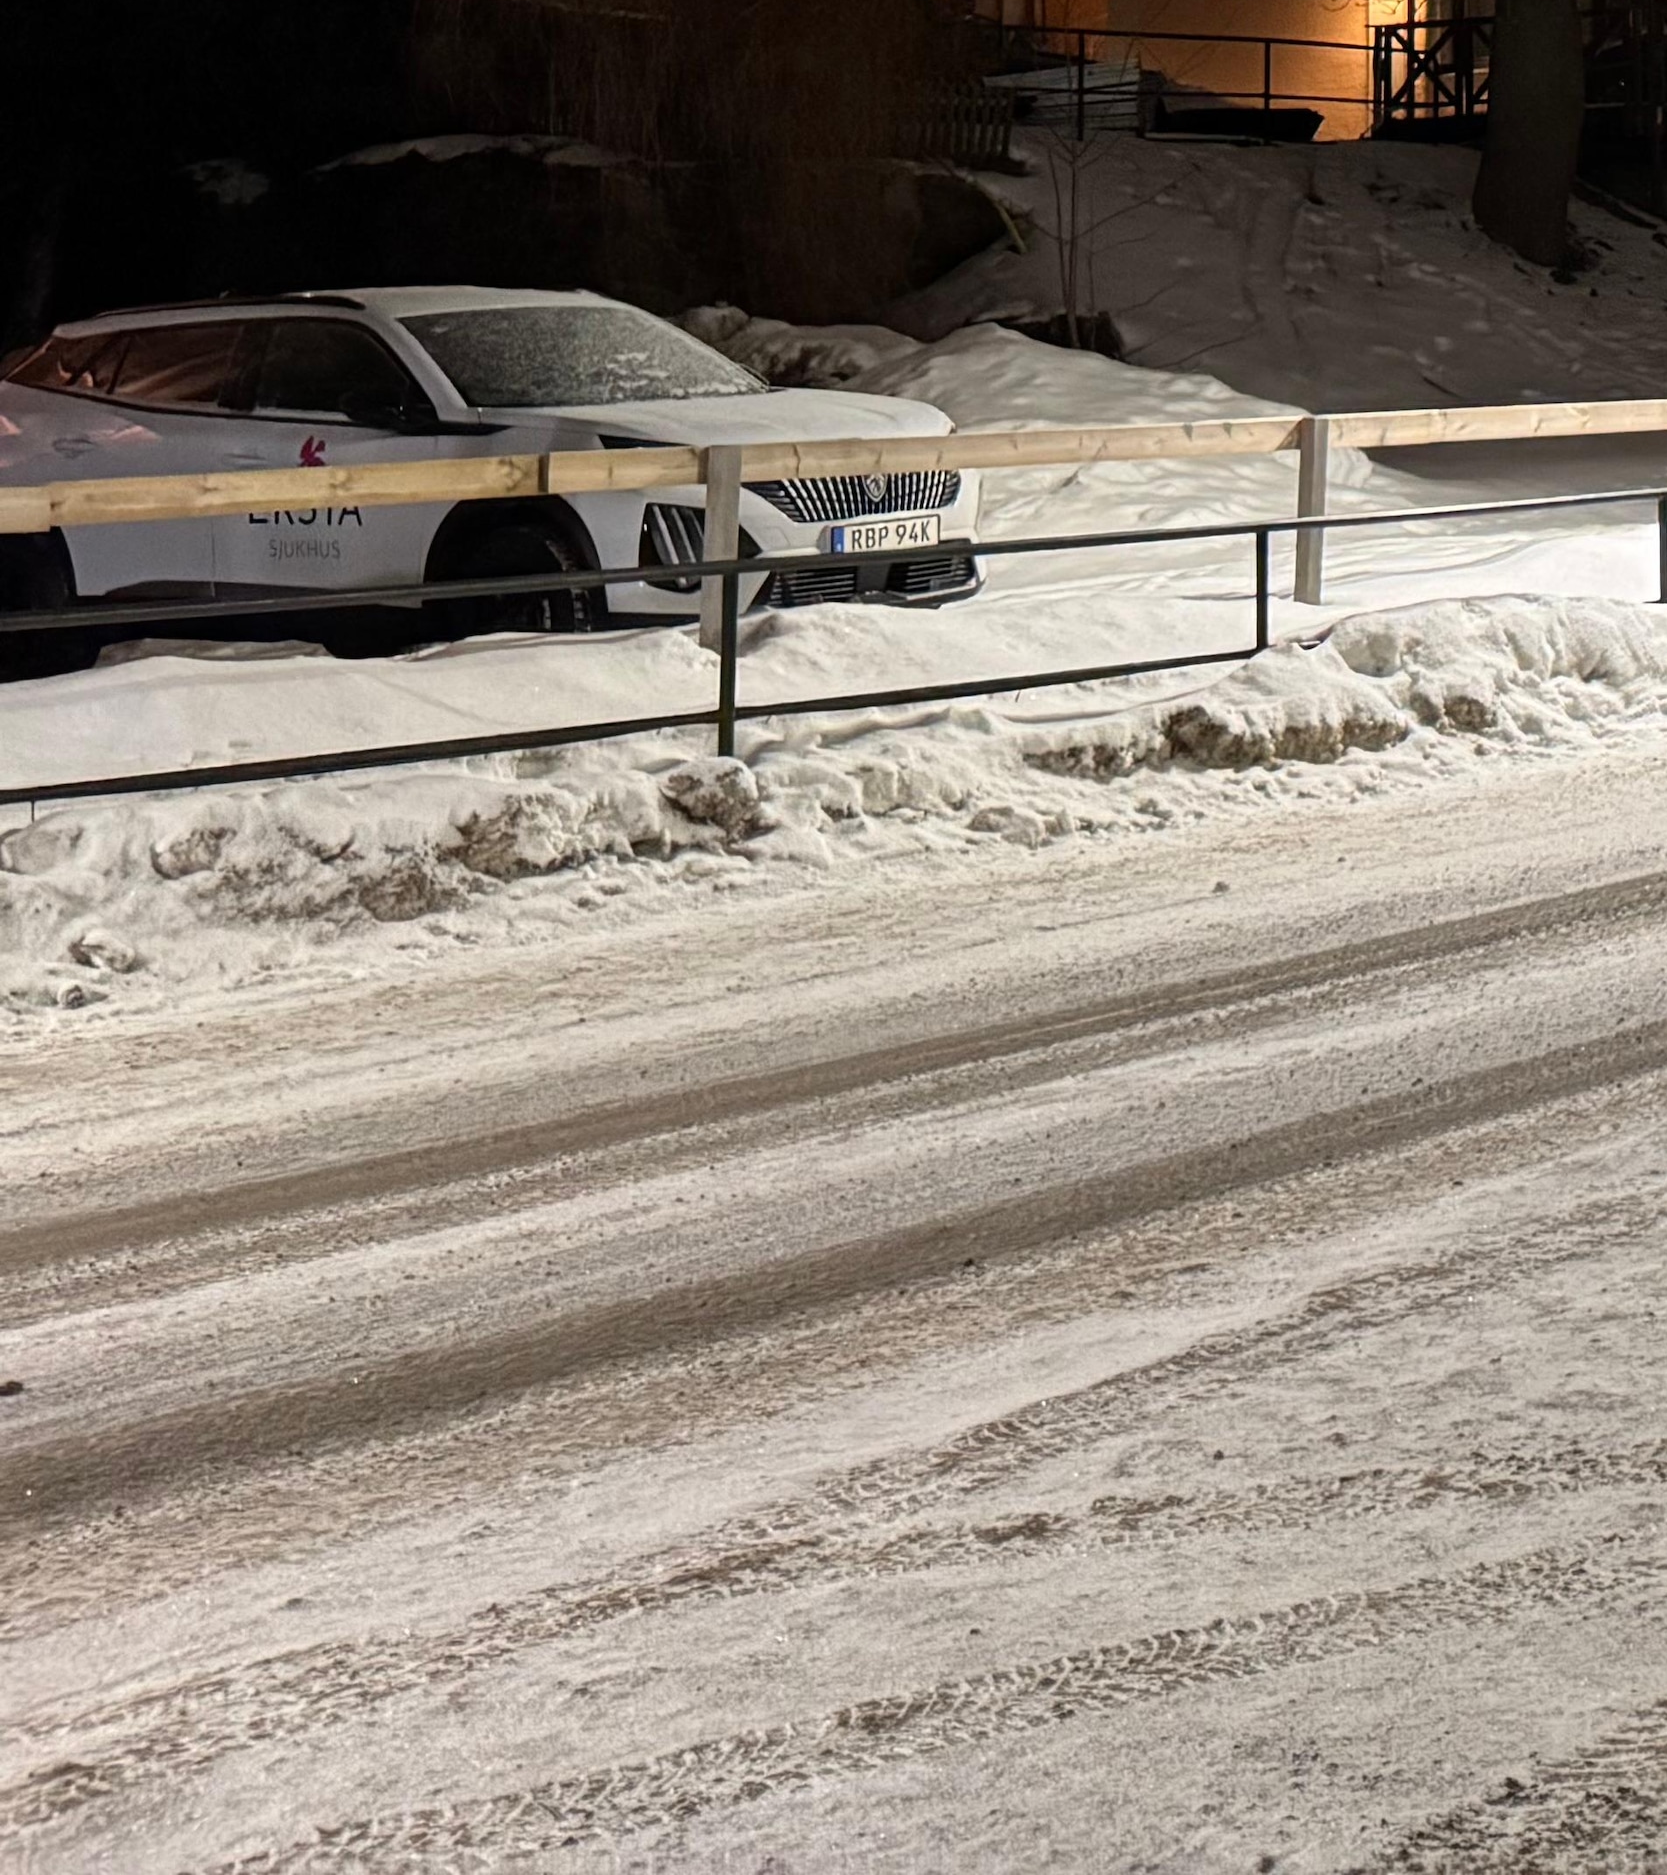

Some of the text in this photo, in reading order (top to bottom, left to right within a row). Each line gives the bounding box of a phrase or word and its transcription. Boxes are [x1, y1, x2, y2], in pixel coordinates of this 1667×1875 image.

[851, 520, 930, 550] RBP 94K
[268, 539, 341, 560] SJUKHUS
